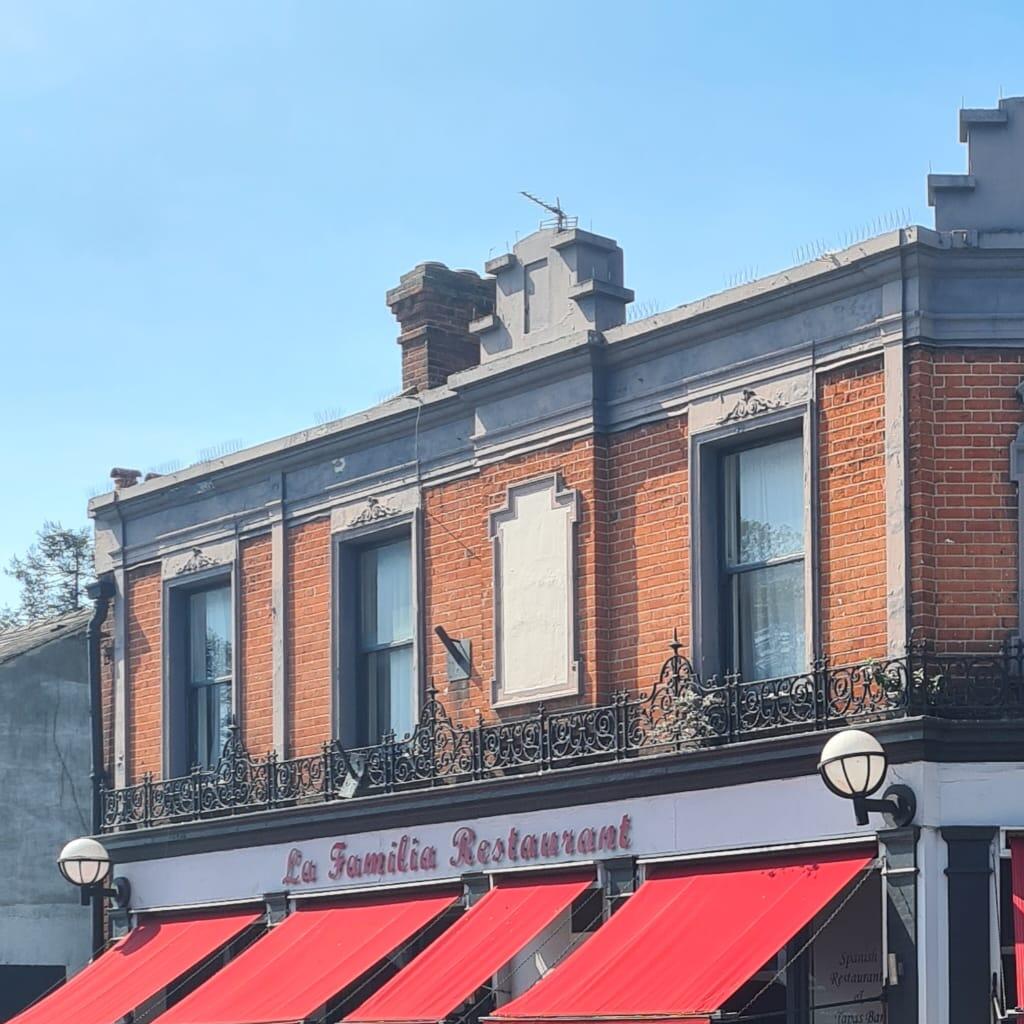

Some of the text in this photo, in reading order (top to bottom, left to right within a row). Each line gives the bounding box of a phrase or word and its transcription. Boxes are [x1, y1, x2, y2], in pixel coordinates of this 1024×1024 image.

[282, 813, 633, 885] La Familia Restaurant
